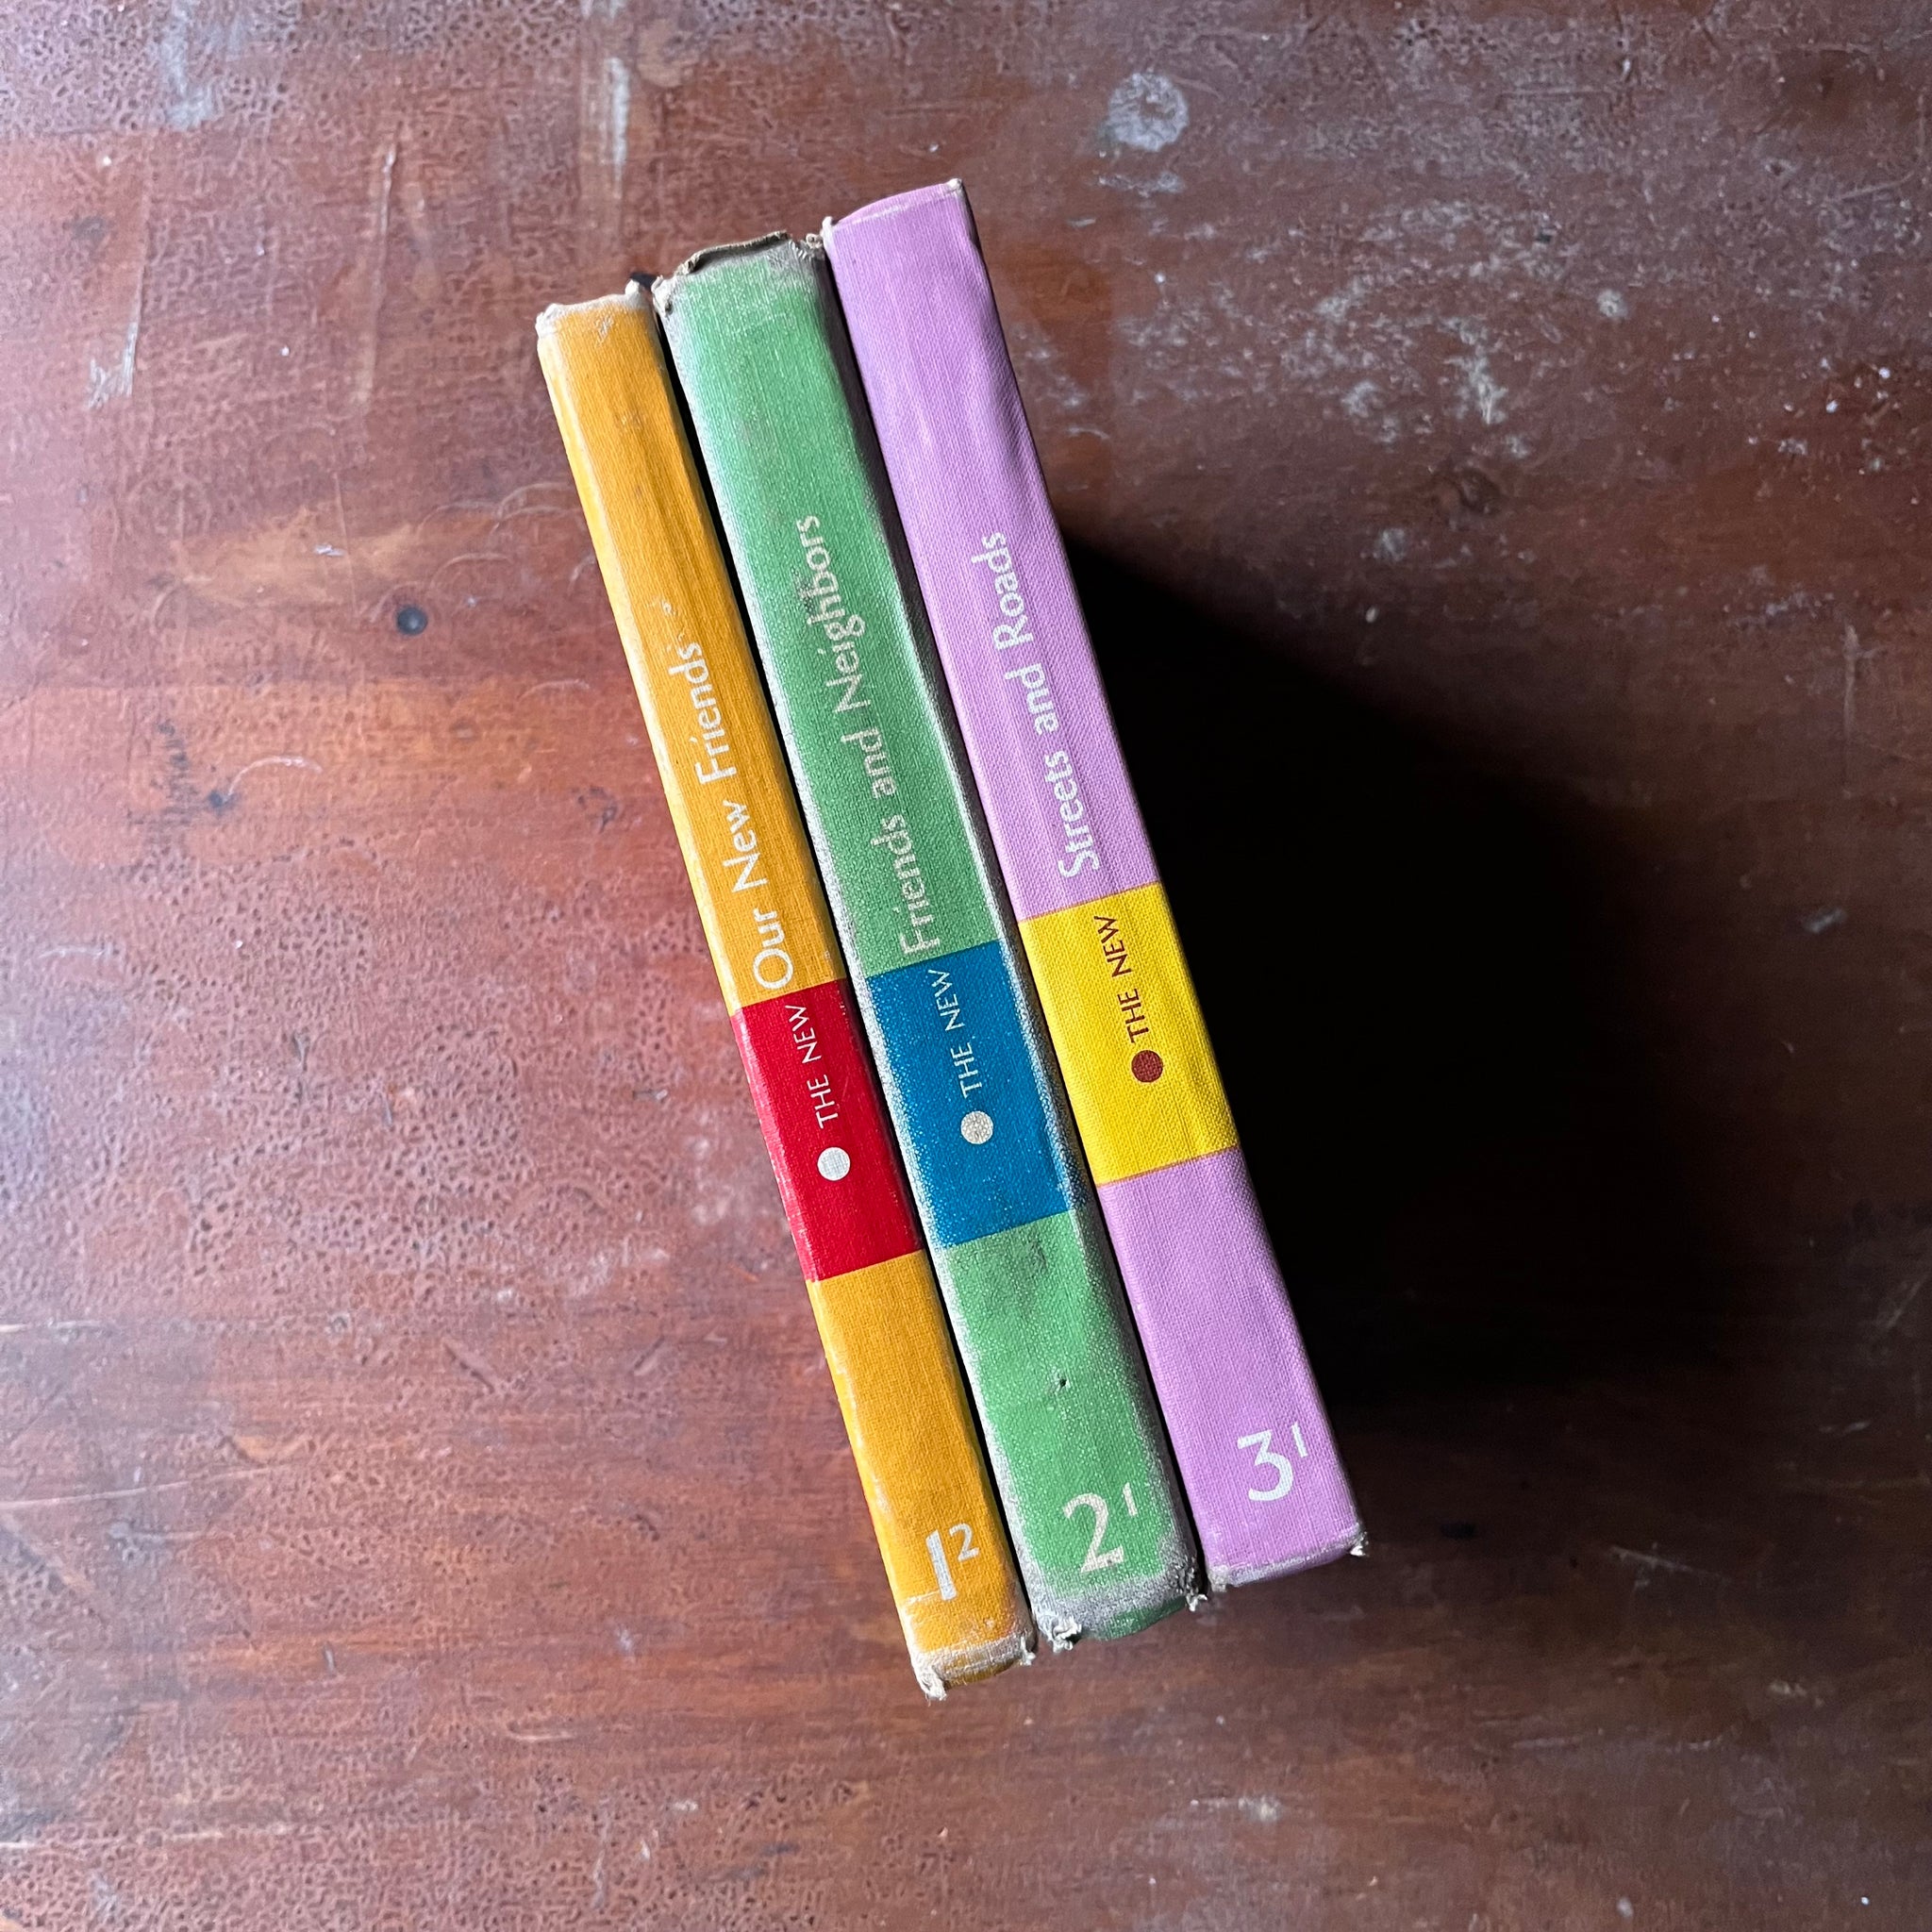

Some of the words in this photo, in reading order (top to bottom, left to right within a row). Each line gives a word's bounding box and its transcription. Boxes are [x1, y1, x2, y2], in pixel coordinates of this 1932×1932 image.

[796, 514, 872, 715] Neighbors
[971, 531, 1034, 651] Roads
[668, 641, 738, 786] Friends
[1005, 663, 1059, 736] and
[840, 725, 896, 799] and
[722, 800, 769, 893] New
[1044, 750, 1102, 878] Streets
[870, 814, 941, 956] Friends
[752, 908, 794, 991] Our
[1092, 915, 1131, 976] NEW
[784, 1003, 822, 1064] NEW
[927, 968, 966, 1033] NEW
[1117, 988, 1150, 1043] THE
[806, 1074, 839, 1129] THE
[950, 1042, 983, 1099] THE
